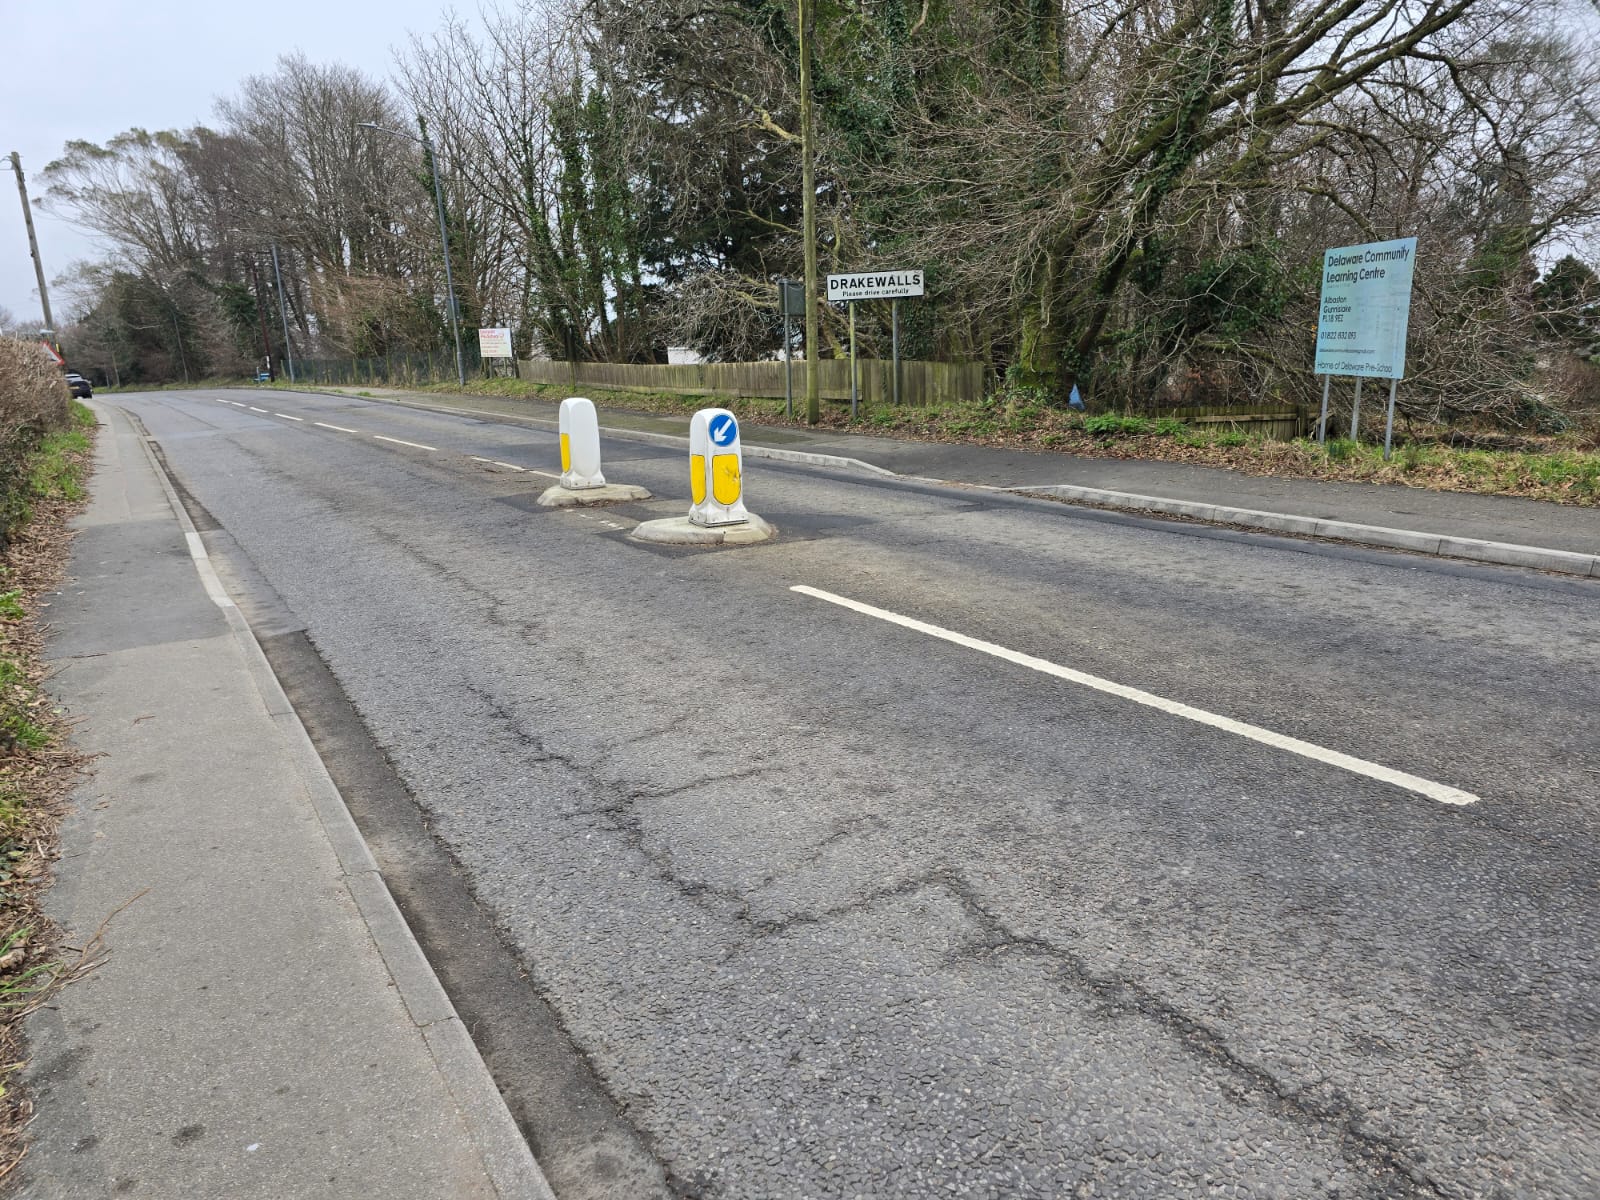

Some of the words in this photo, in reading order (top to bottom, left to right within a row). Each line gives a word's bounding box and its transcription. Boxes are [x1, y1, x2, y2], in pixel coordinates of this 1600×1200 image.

[1328, 253, 1363, 267] Delaware
[1364, 244, 1410, 262] Community
[830, 274, 921, 290] DRAKEWALLS
[1326, 270, 1358, 283] Learning
[1359, 267, 1386, 280] Centre
[1317, 362, 1334, 370] Home
